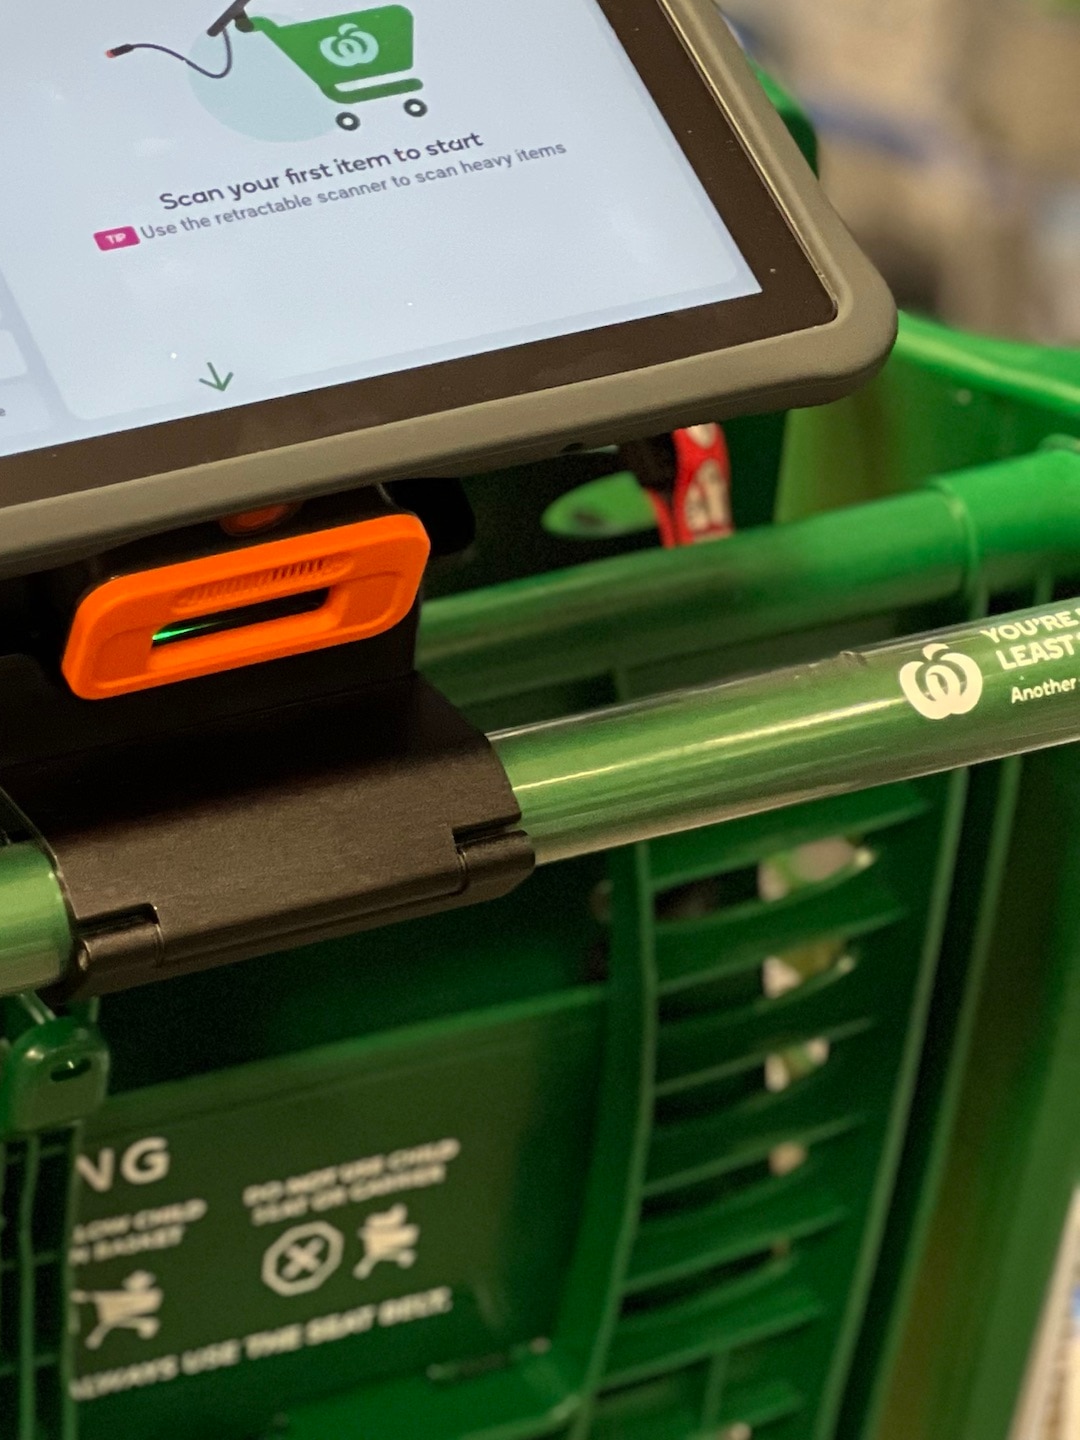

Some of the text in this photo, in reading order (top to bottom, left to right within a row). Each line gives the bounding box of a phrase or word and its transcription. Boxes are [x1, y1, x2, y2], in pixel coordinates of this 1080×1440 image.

[159, 132, 484, 210] Scan your first item to start
[105, 142, 567, 245] TIP Use the retractable scanner to scan heavy items
[980, 611, 1079, 643] YOU'RE
[996, 634, 1075, 671] LEAST
[1011, 678, 1077, 704] Another
[386, 1137, 461, 1172] CHILD
[133, 1198, 207, 1231] CHILD
[181, 1339, 241, 1375] USE
[244, 1323, 302, 1359] THE
[306, 1304, 375, 1346] SEAT
